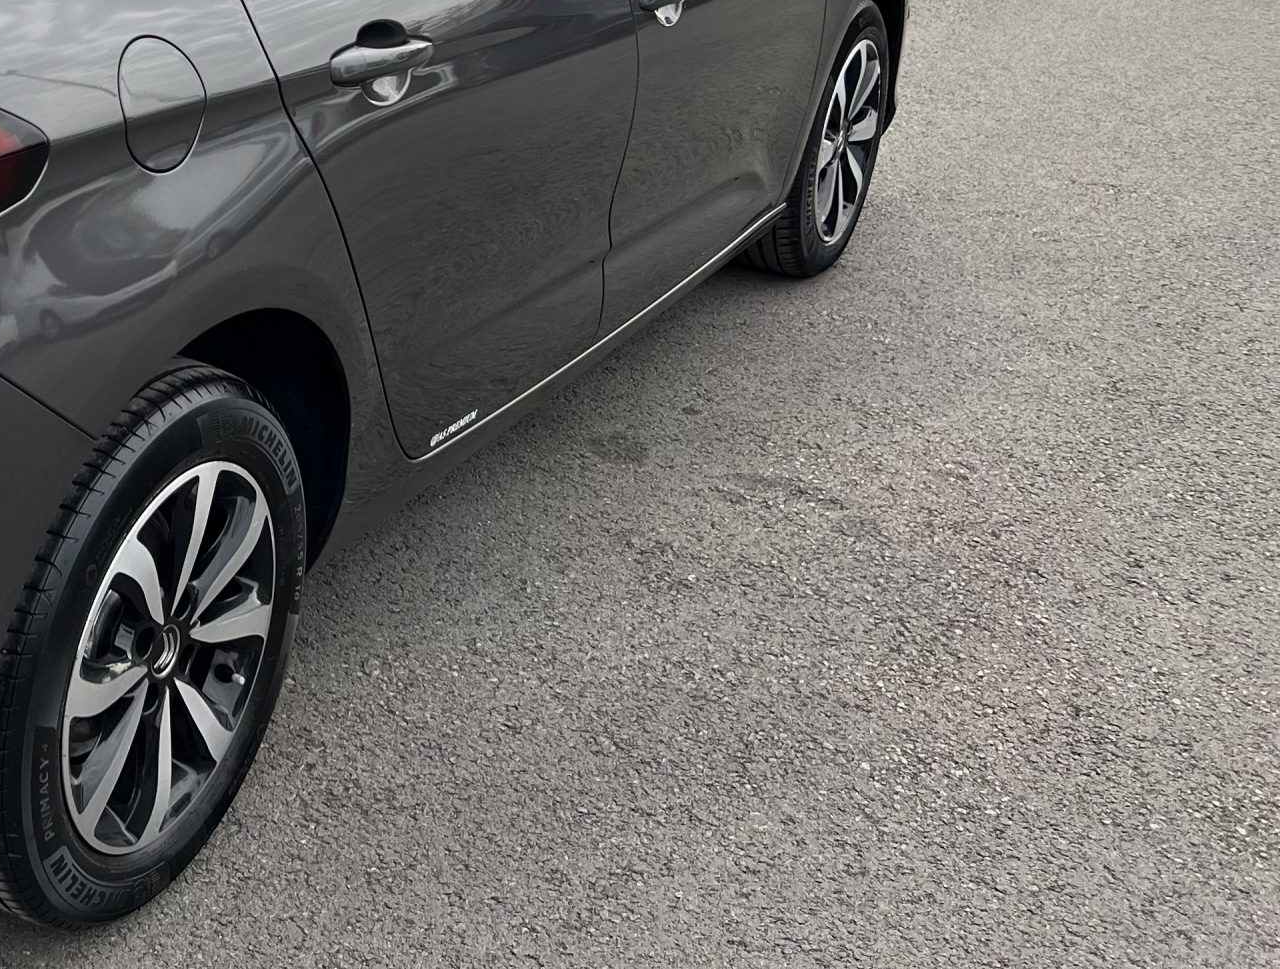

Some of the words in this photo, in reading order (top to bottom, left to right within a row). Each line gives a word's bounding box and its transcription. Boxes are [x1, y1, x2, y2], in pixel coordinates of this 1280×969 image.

[241, 415, 299, 488] MICHELIN
[296, 566, 303, 577] R
[38, 758, 55, 842] PRIMACY
